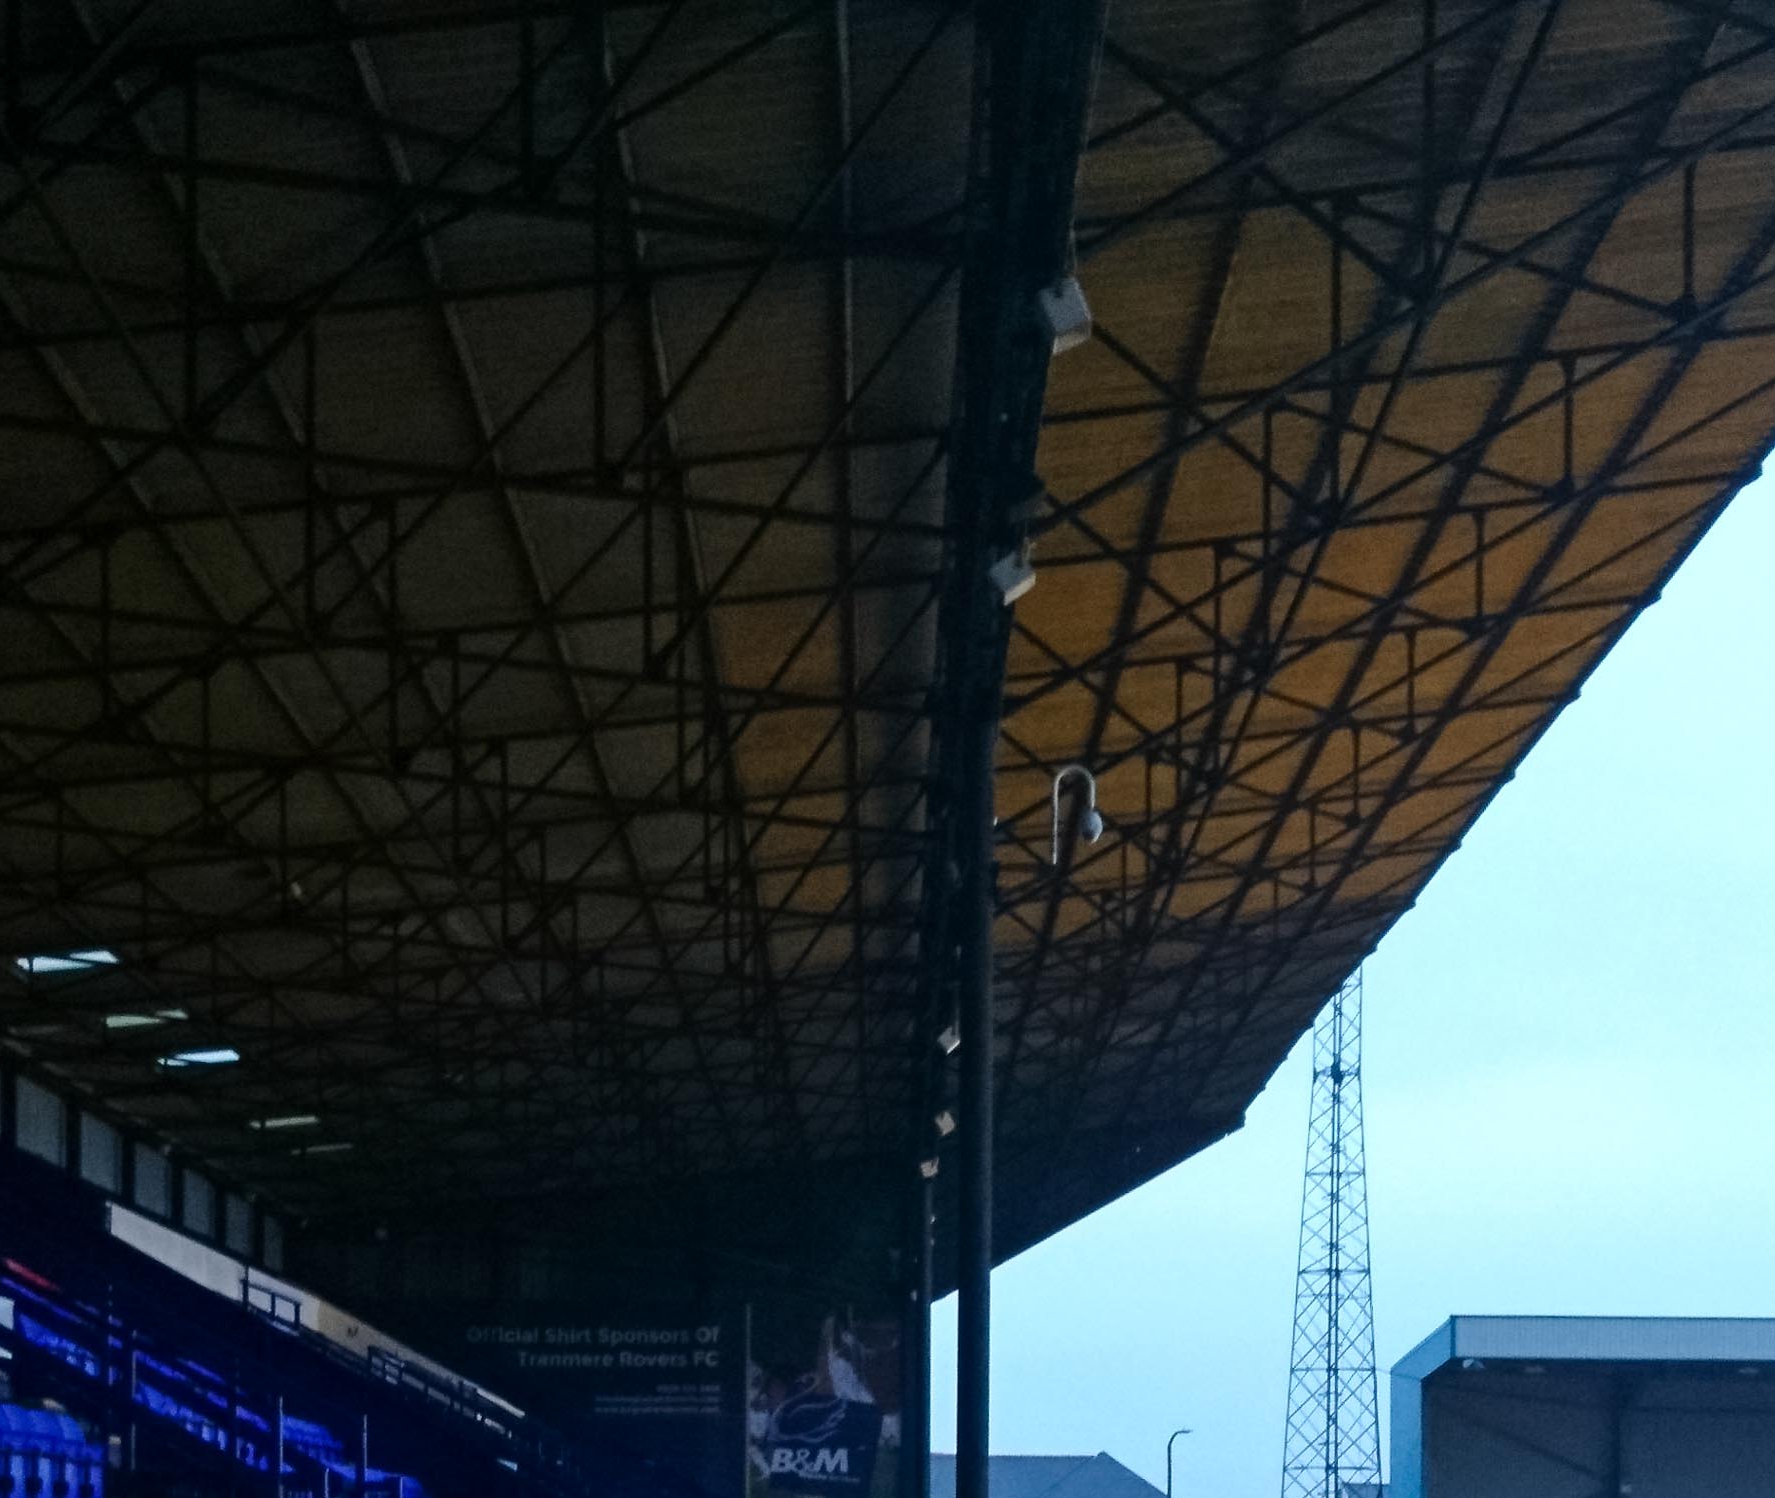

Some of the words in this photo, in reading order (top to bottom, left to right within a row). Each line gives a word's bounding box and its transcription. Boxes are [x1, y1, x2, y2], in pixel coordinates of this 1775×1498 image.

[466, 1326, 538, 1344] Official
[545, 1327, 592, 1344] Shirt
[598, 1327, 689, 1347] Sponsors
[517, 1351, 614, 1367] Tranmere
[619, 1351, 687, 1367] Rovers
[693, 1351, 720, 1367] FC
[770, 1447, 849, 1474] B&M
